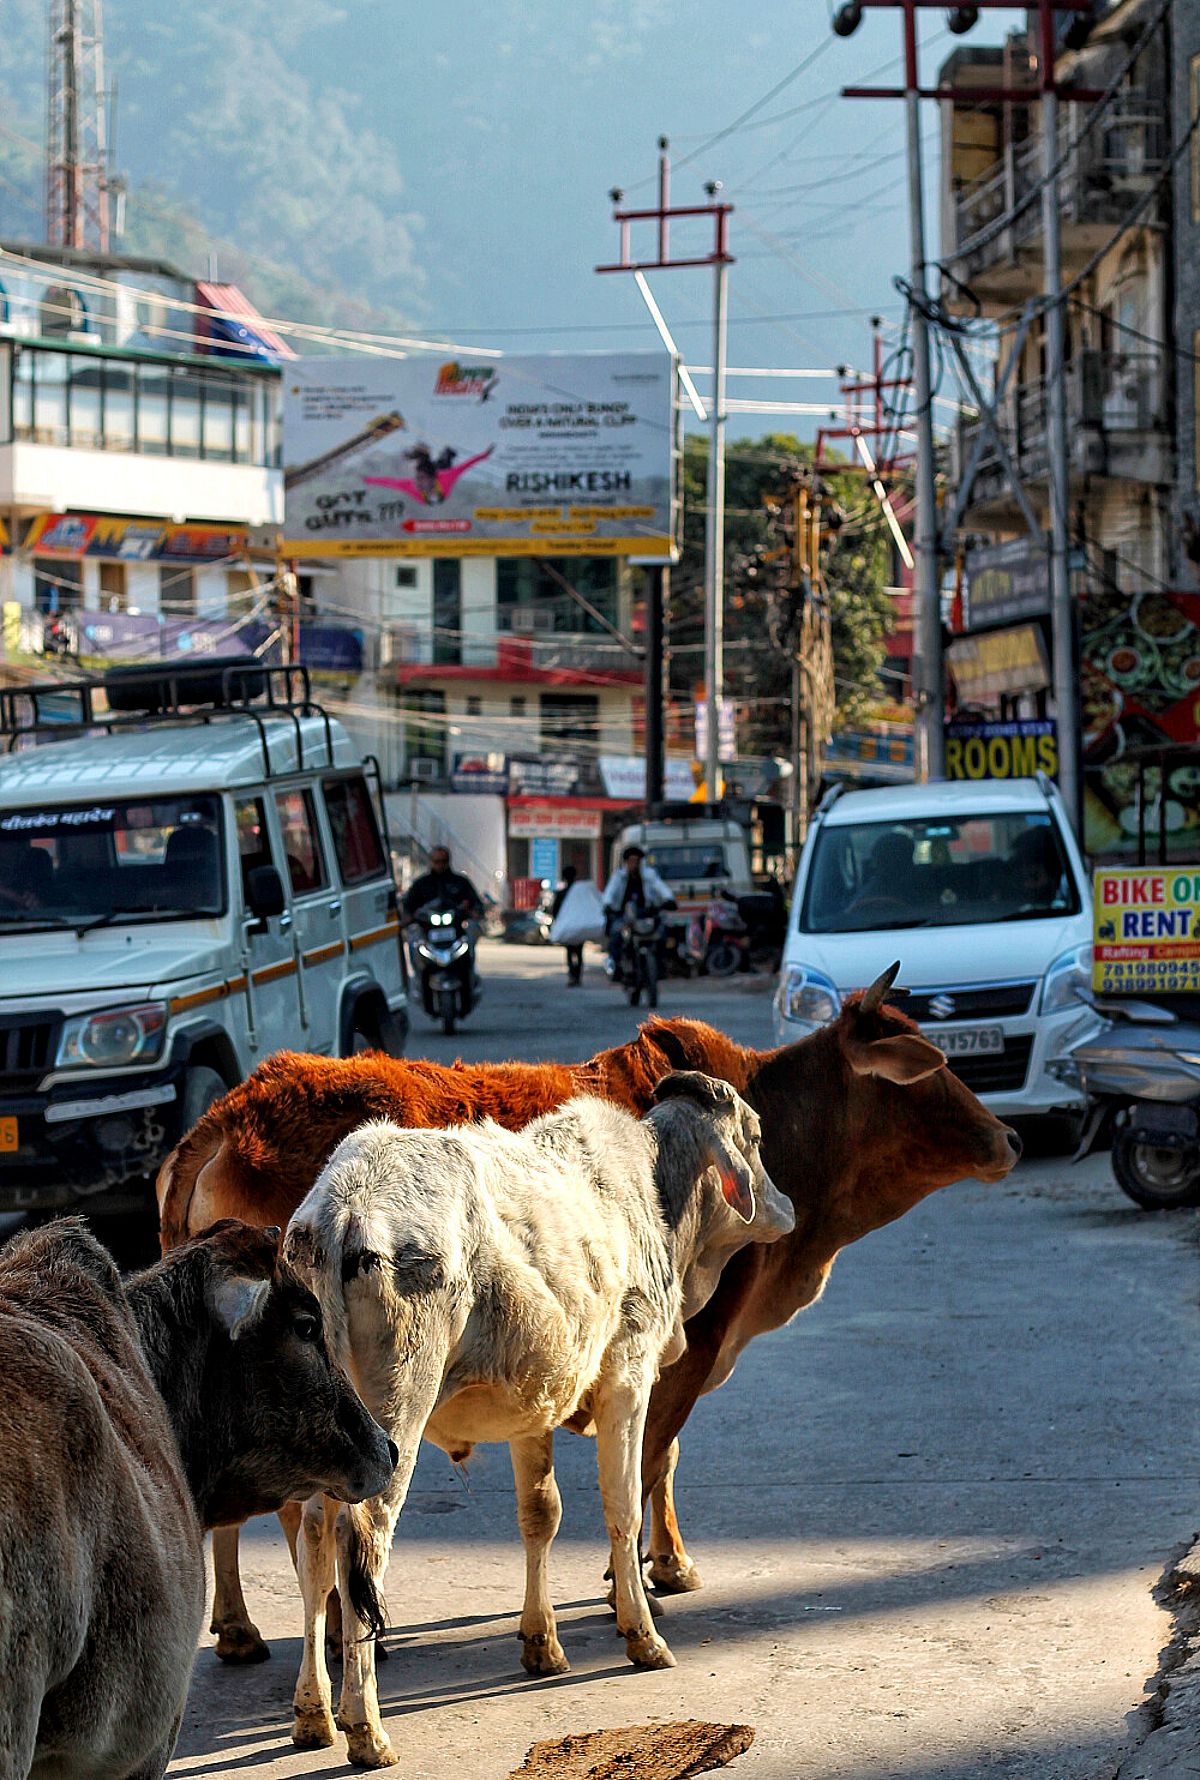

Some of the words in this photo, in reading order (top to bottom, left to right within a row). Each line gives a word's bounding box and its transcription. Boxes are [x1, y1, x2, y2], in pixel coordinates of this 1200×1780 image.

[506, 470, 631, 492] RISHIKESH
[945, 735, 1057, 779] ROOMS
[1103, 878, 1165, 905] BIKE
[1123, 910, 1192, 938] RENT
[1103, 945, 1149, 960] Rafting
